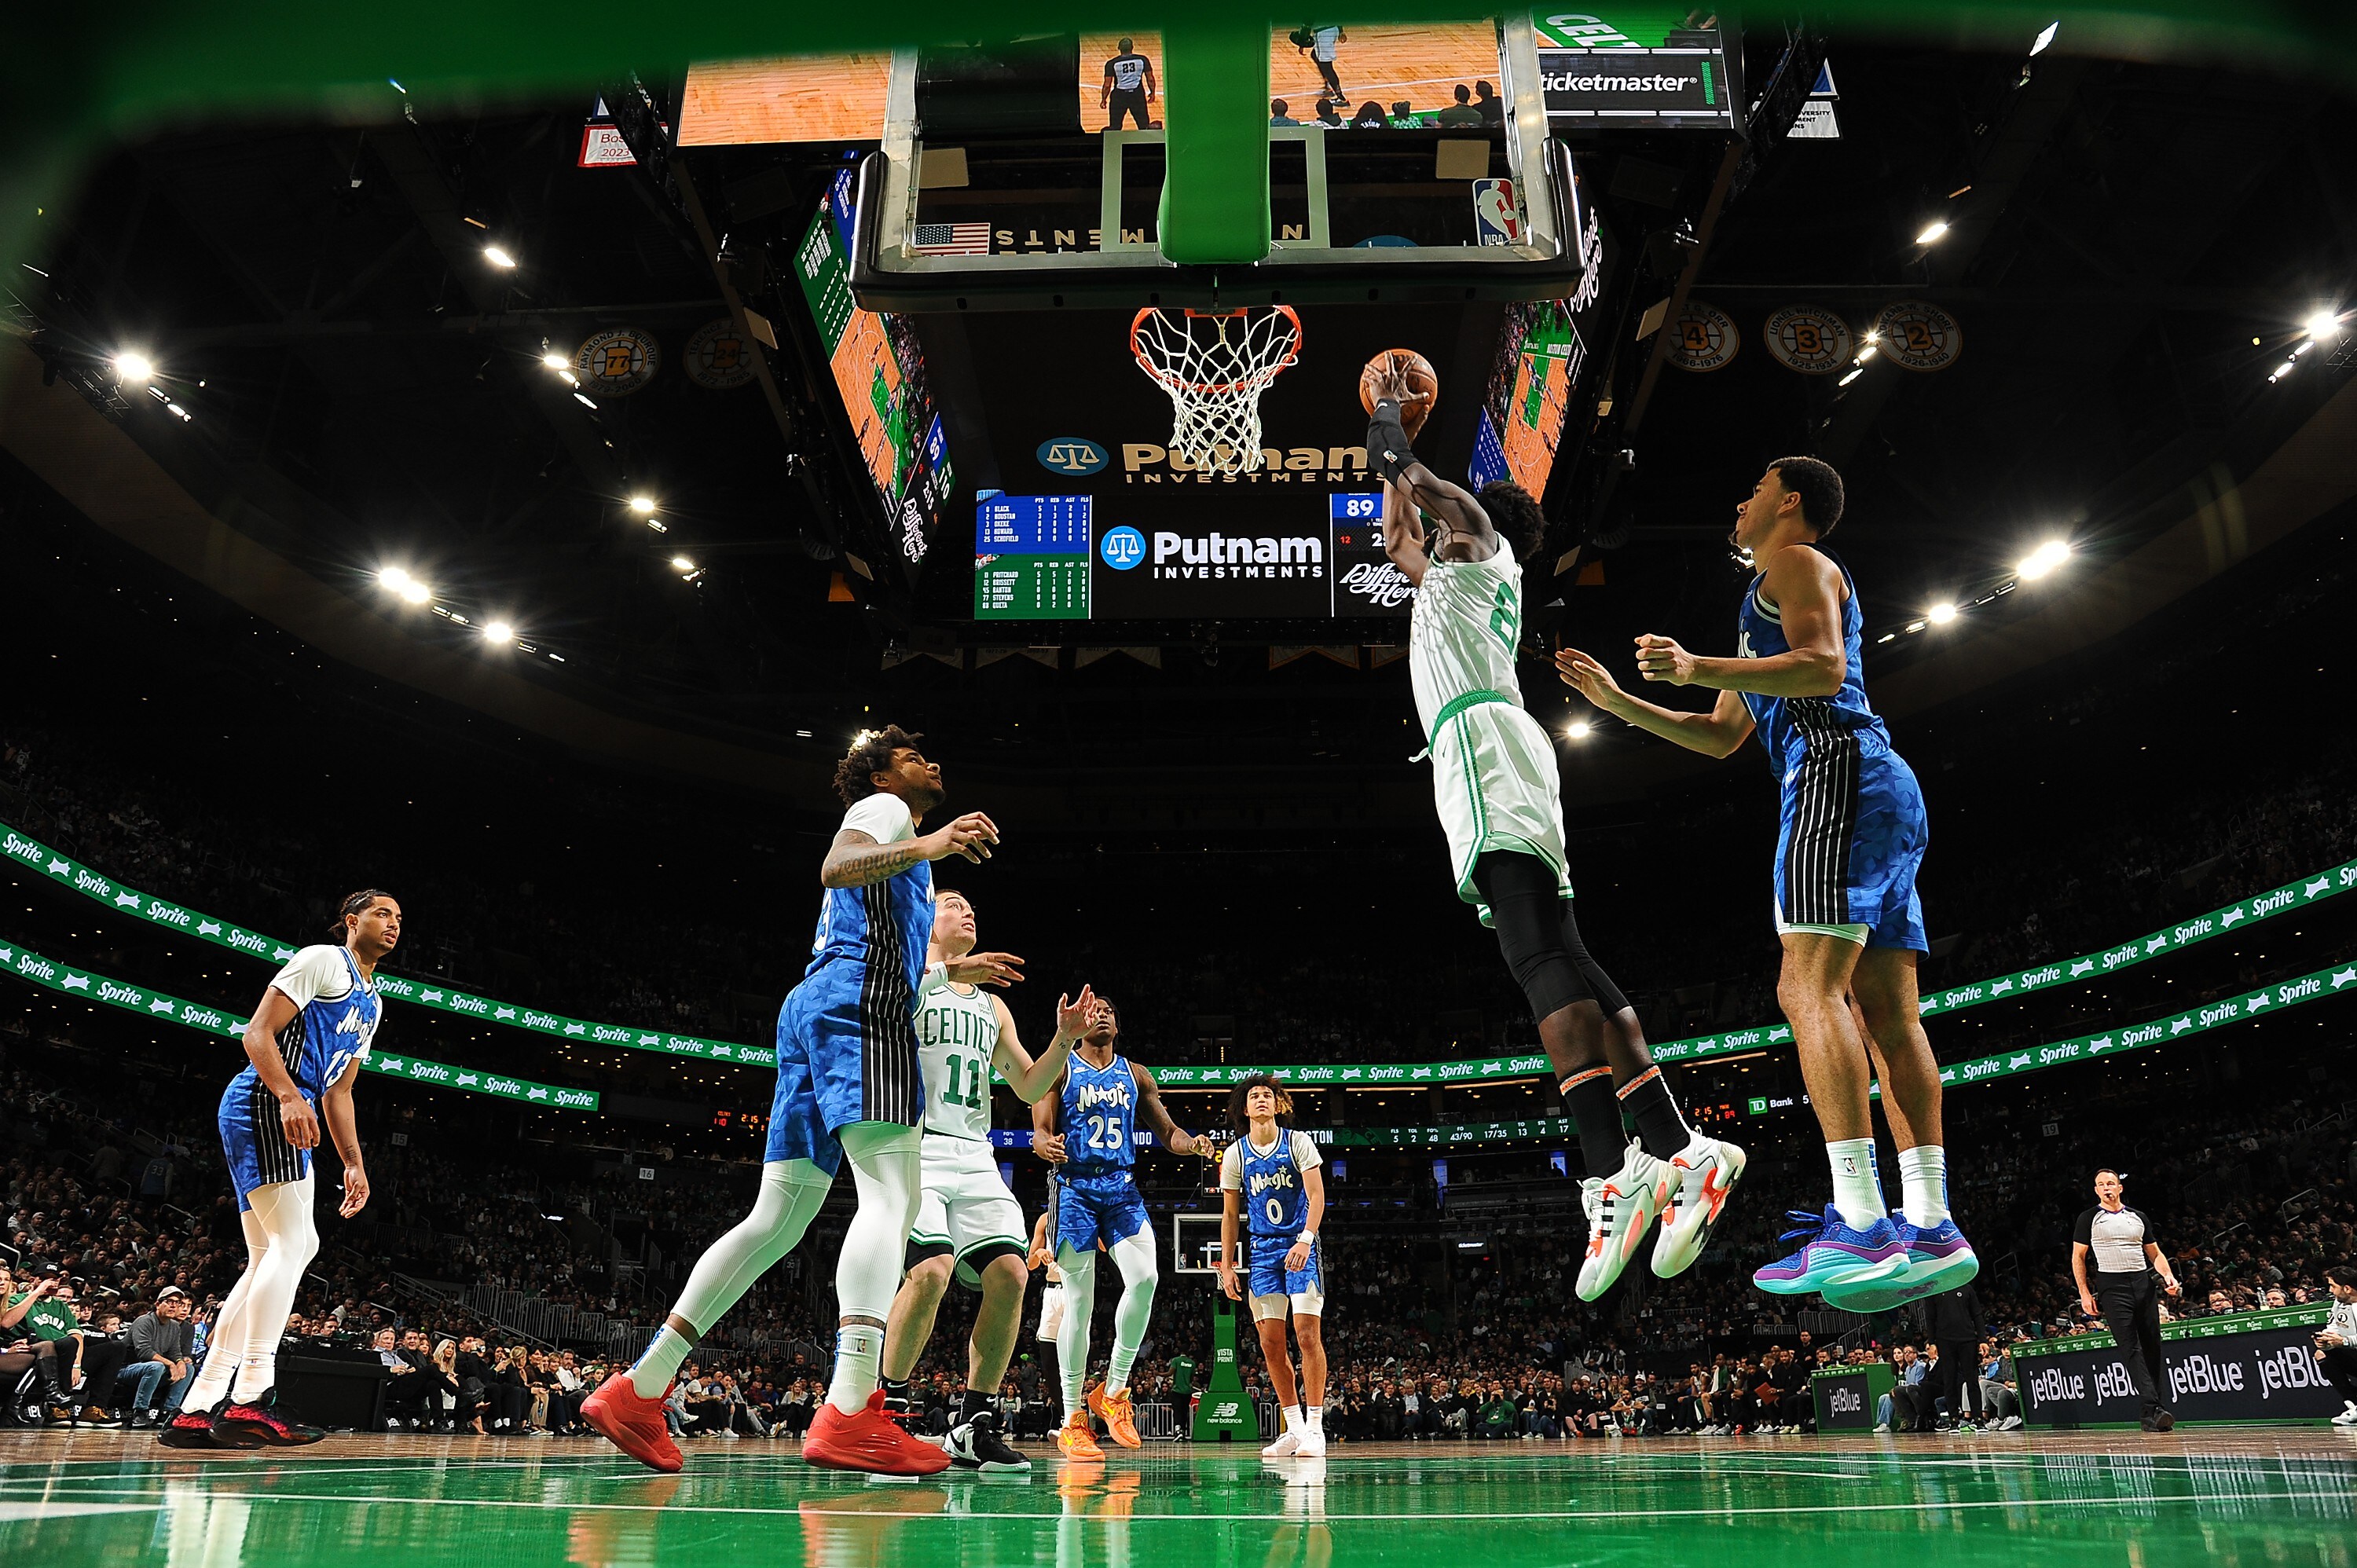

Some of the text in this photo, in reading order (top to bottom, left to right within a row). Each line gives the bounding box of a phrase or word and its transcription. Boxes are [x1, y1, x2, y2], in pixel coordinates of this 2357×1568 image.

[1122, 62, 1136, 74] 23
[601, 148, 629, 157] 2023
[1708, 310, 1729, 328] ORR
[1769, 308, 1846, 336] LIONEL HITCHMAN
[1923, 306, 1955, 332] SHORE
[1687, 325, 1704, 345] 4
[1799, 330, 1817, 349] 3
[1909, 326, 1928, 346] 2
[580, 331, 614, 369] RAYMOND
[628, 331, 656, 366] BOURQUE
[1672, 352, 1724, 368] 1966-1976
[1901, 352, 1949, 367] 1926-1940
[607, 355, 629, 368] 77
[1787, 357, 1837, 370] 1925-1934
[588, 377, 642, 393] 1979-2000
[1347, 499, 1374, 517] 89
[1153, 532, 1322, 564] Putnam
[1153, 566, 1323, 578] INVESTMENTS
[2, 833, 774, 1063] Sprite Sprite Sprite Sprite Sprite Sprite Sprite Sprite Sprite Sprite
[1157, 1068, 1194, 1083] Sprite
[1298, 1067, 1334, 1082] Sprite
[1368, 1066, 1404, 1081] Sprite
[1438, 1063, 1474, 1079] Sprite
[1508, 1057, 1545, 1073] Sprite
[1652, 1043, 1688, 1061] Sprite
[1723, 1031, 1760, 1050] Sprite
[1945, 987, 1982, 1008] Sprite
[2020, 967, 2061, 990] Sprite
[2102, 945, 2138, 969] Sprite
[2174, 918, 2212, 945] Sprite
[2253, 889, 2294, 917] Sprite
[16, 954, 594, 1106] Sprite Sprite Sprite Sprite Sprite Sprite
[923, 1007, 997, 1061] CELTICS
[1963, 978, 2321, 1080] Sprite Sprite Sprite Sprite Sprite
[324, 1049, 353, 1088] 13
[944, 1053, 981, 1110] 11
[1076, 1080, 1131, 1112] Magic
[1750, 1097, 1794, 1112] TD Bank
[741, 1114, 758, 1123] 2:15
[1695, 1106, 1713, 1116] 2:15
[1087, 1116, 1123, 1150] 25
[1250, 1172, 1293, 1196] Magic
[1266, 1198, 1283, 1225] 0
[1217, 1348, 1233, 1357] VISTA
[2029, 1346, 2332, 1409] jetBlue jetBl jetBlue jetBlu
[1830, 1387, 1860, 1419] jetBlue
